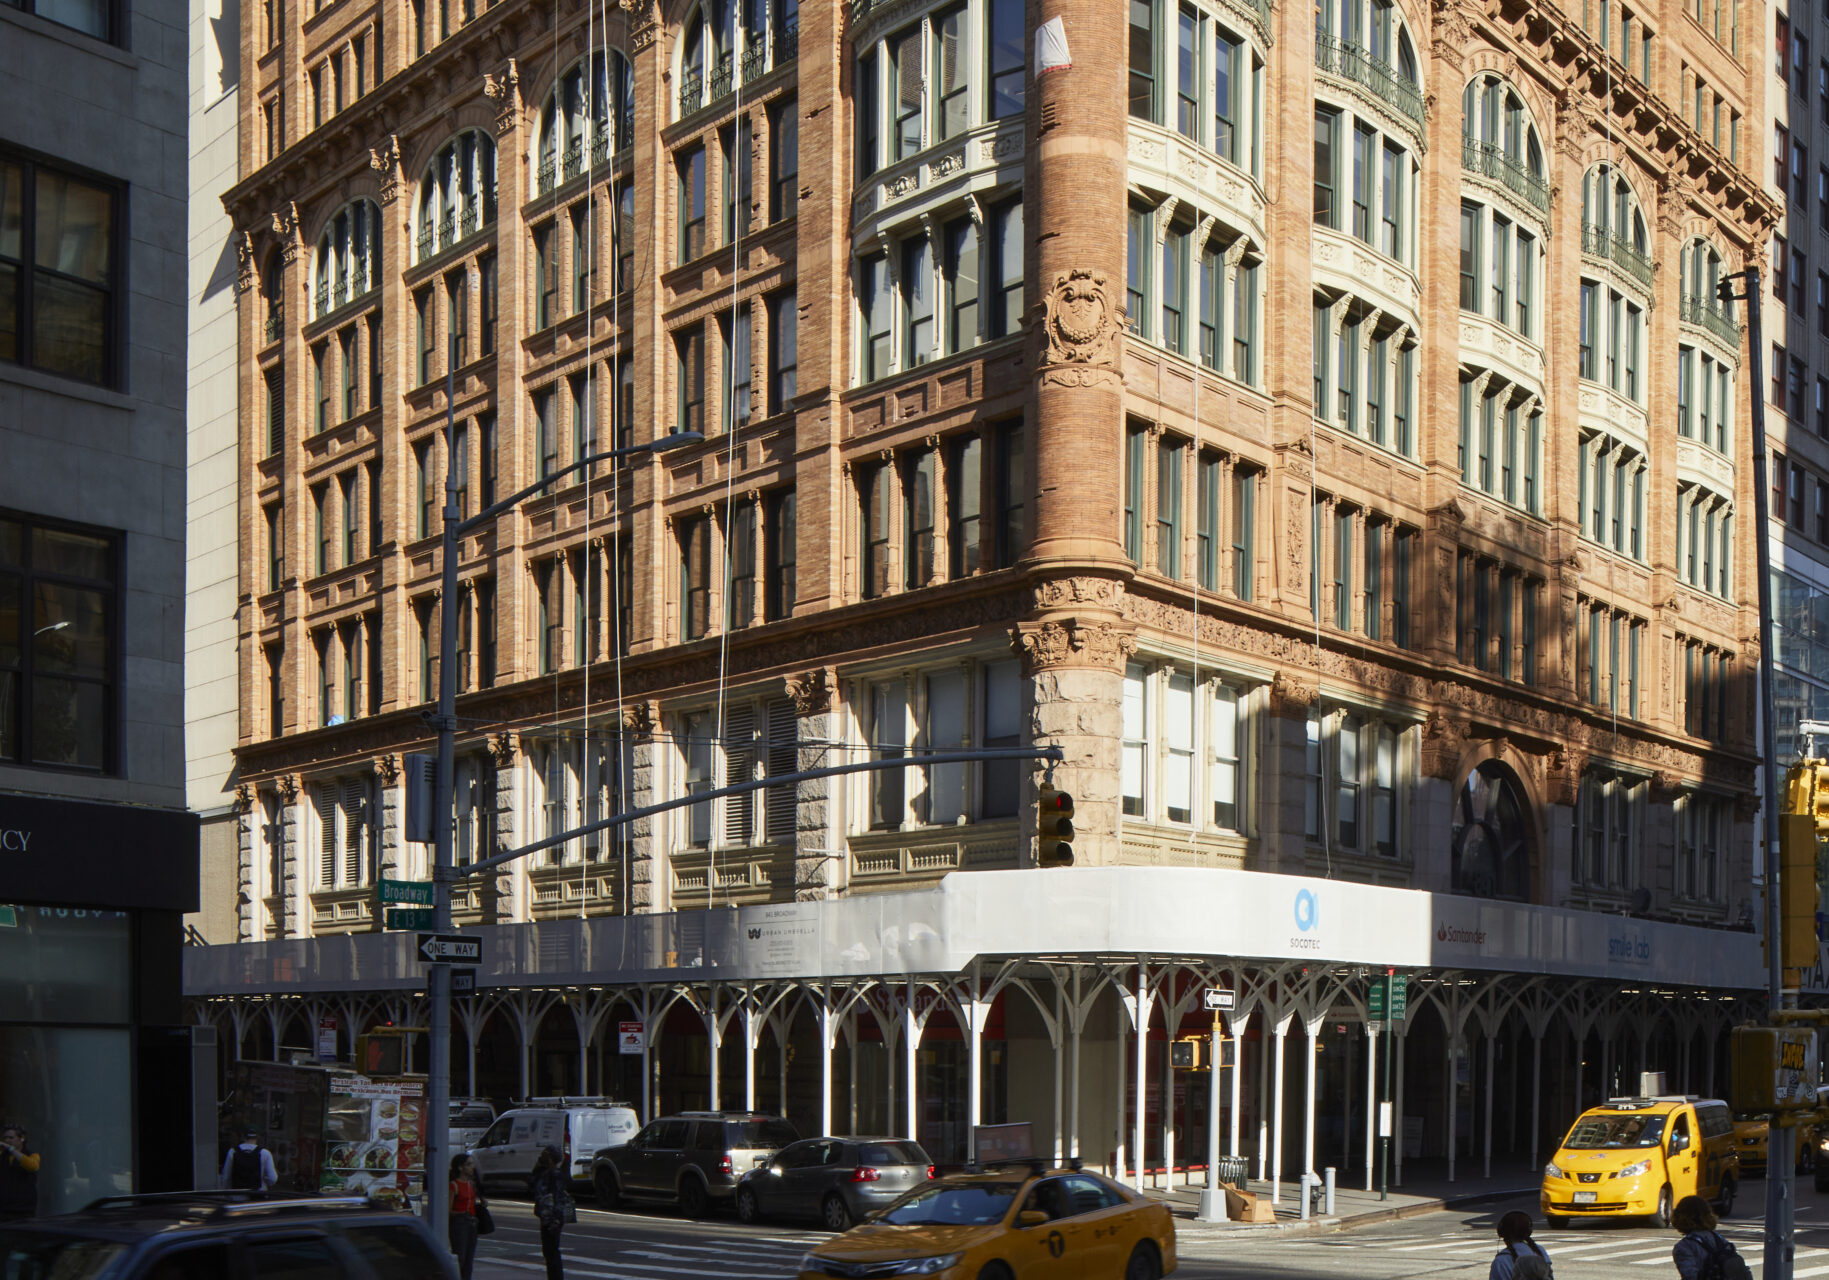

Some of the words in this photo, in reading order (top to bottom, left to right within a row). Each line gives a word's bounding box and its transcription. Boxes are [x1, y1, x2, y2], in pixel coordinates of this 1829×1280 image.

[0, 829, 31, 851] CY
[384, 883, 428, 904] Broadway
[394, 912, 400, 927] E
[406, 911, 415, 927] 13
[1290, 937, 1320, 949] SOCOTEC
[1447, 925, 1487, 945] Santander
[427, 942, 446, 955] ONE
[454, 943, 474, 956] WAY
[1609, 934, 1632, 957] smile
[1634, 935, 1650, 959] lab
[455, 976, 470, 987] WAY
